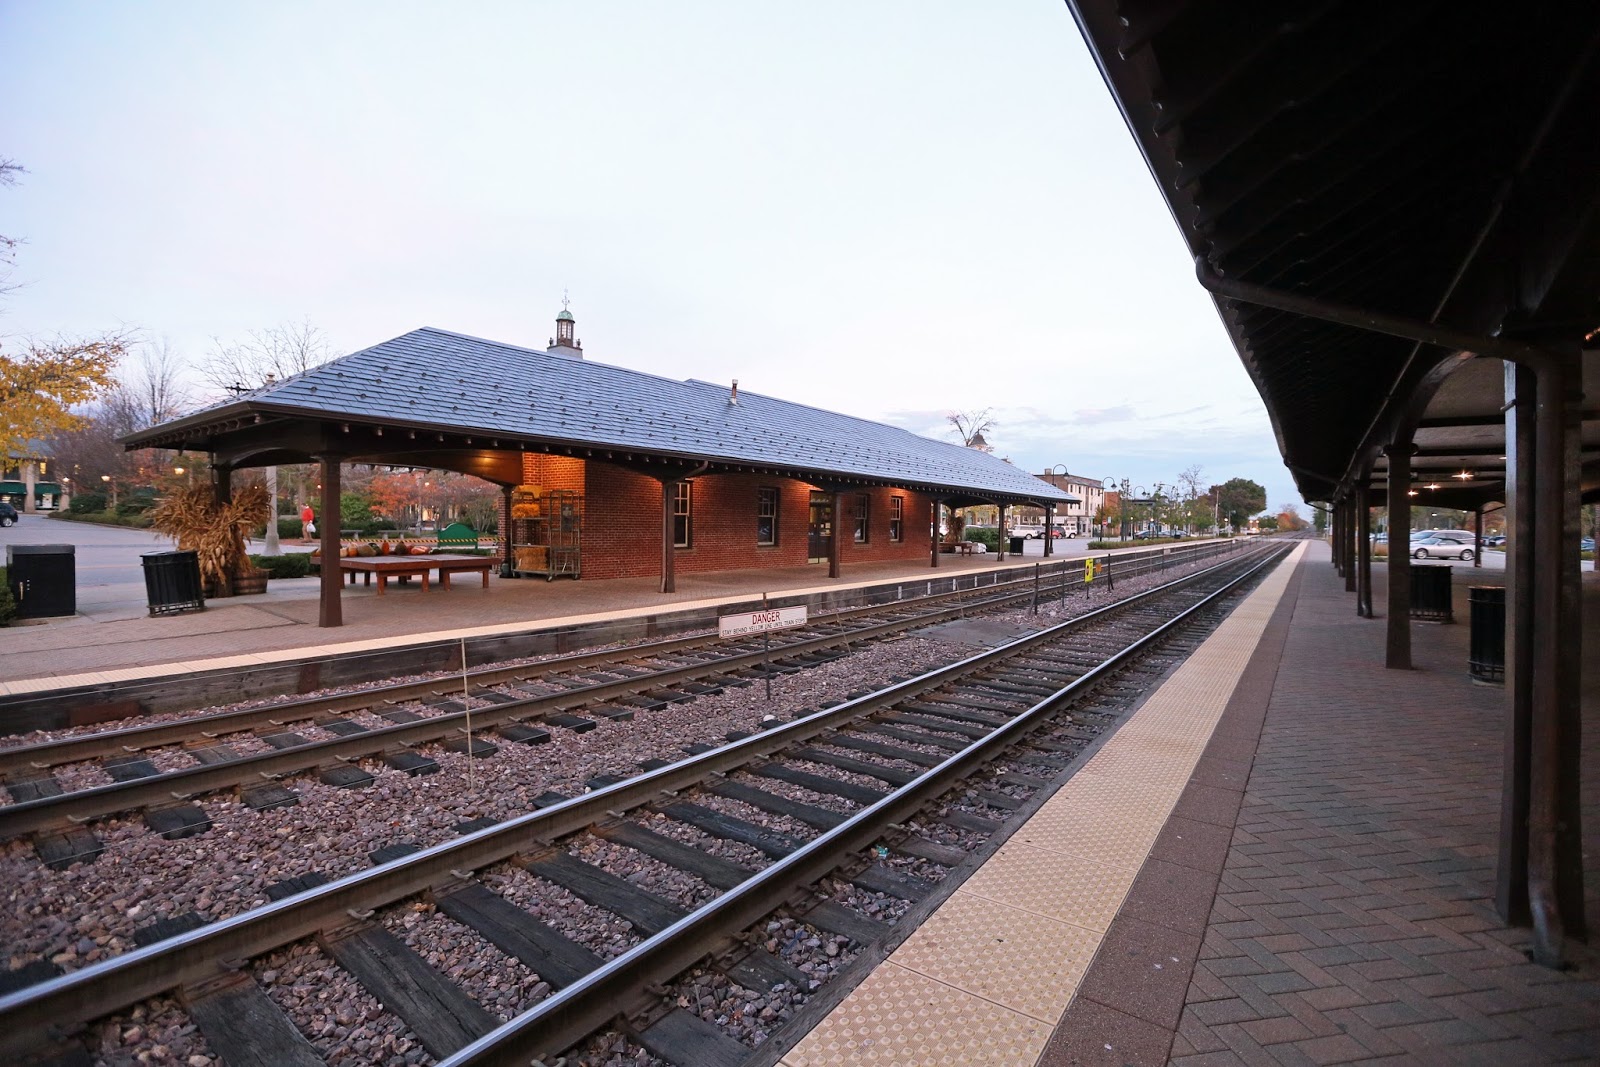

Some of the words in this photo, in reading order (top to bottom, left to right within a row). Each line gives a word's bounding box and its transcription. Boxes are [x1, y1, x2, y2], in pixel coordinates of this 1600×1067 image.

[752, 611, 781, 625] DANGER
[722, 628, 732, 636] STAY
[733, 626, 748, 635] BEHIND
[749, 624, 763, 633] YELLOW
